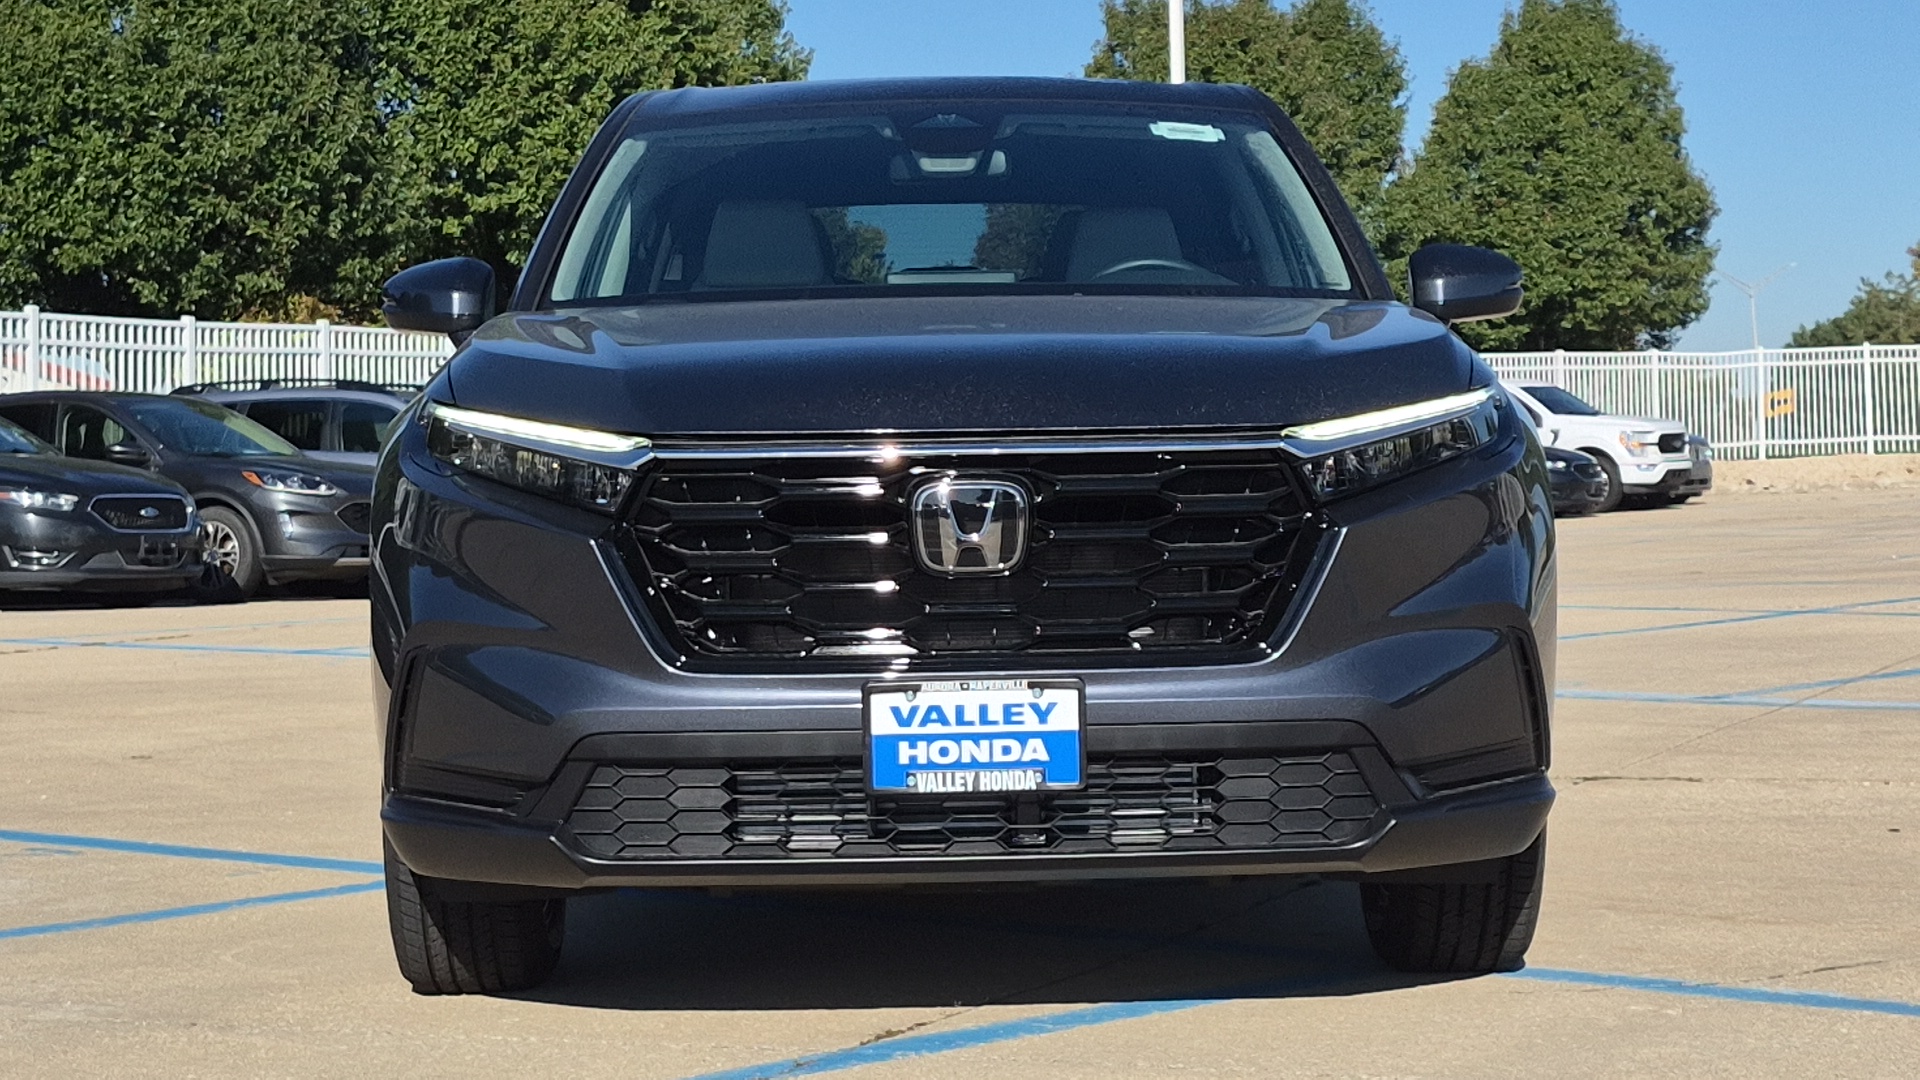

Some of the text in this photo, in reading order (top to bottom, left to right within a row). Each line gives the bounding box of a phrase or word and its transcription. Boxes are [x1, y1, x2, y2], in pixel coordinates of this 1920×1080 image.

[889, 702, 1058, 728] VALLEY
[898, 738, 1050, 765] HONDA
[916, 769, 1037, 793] VALLEY HONDA
